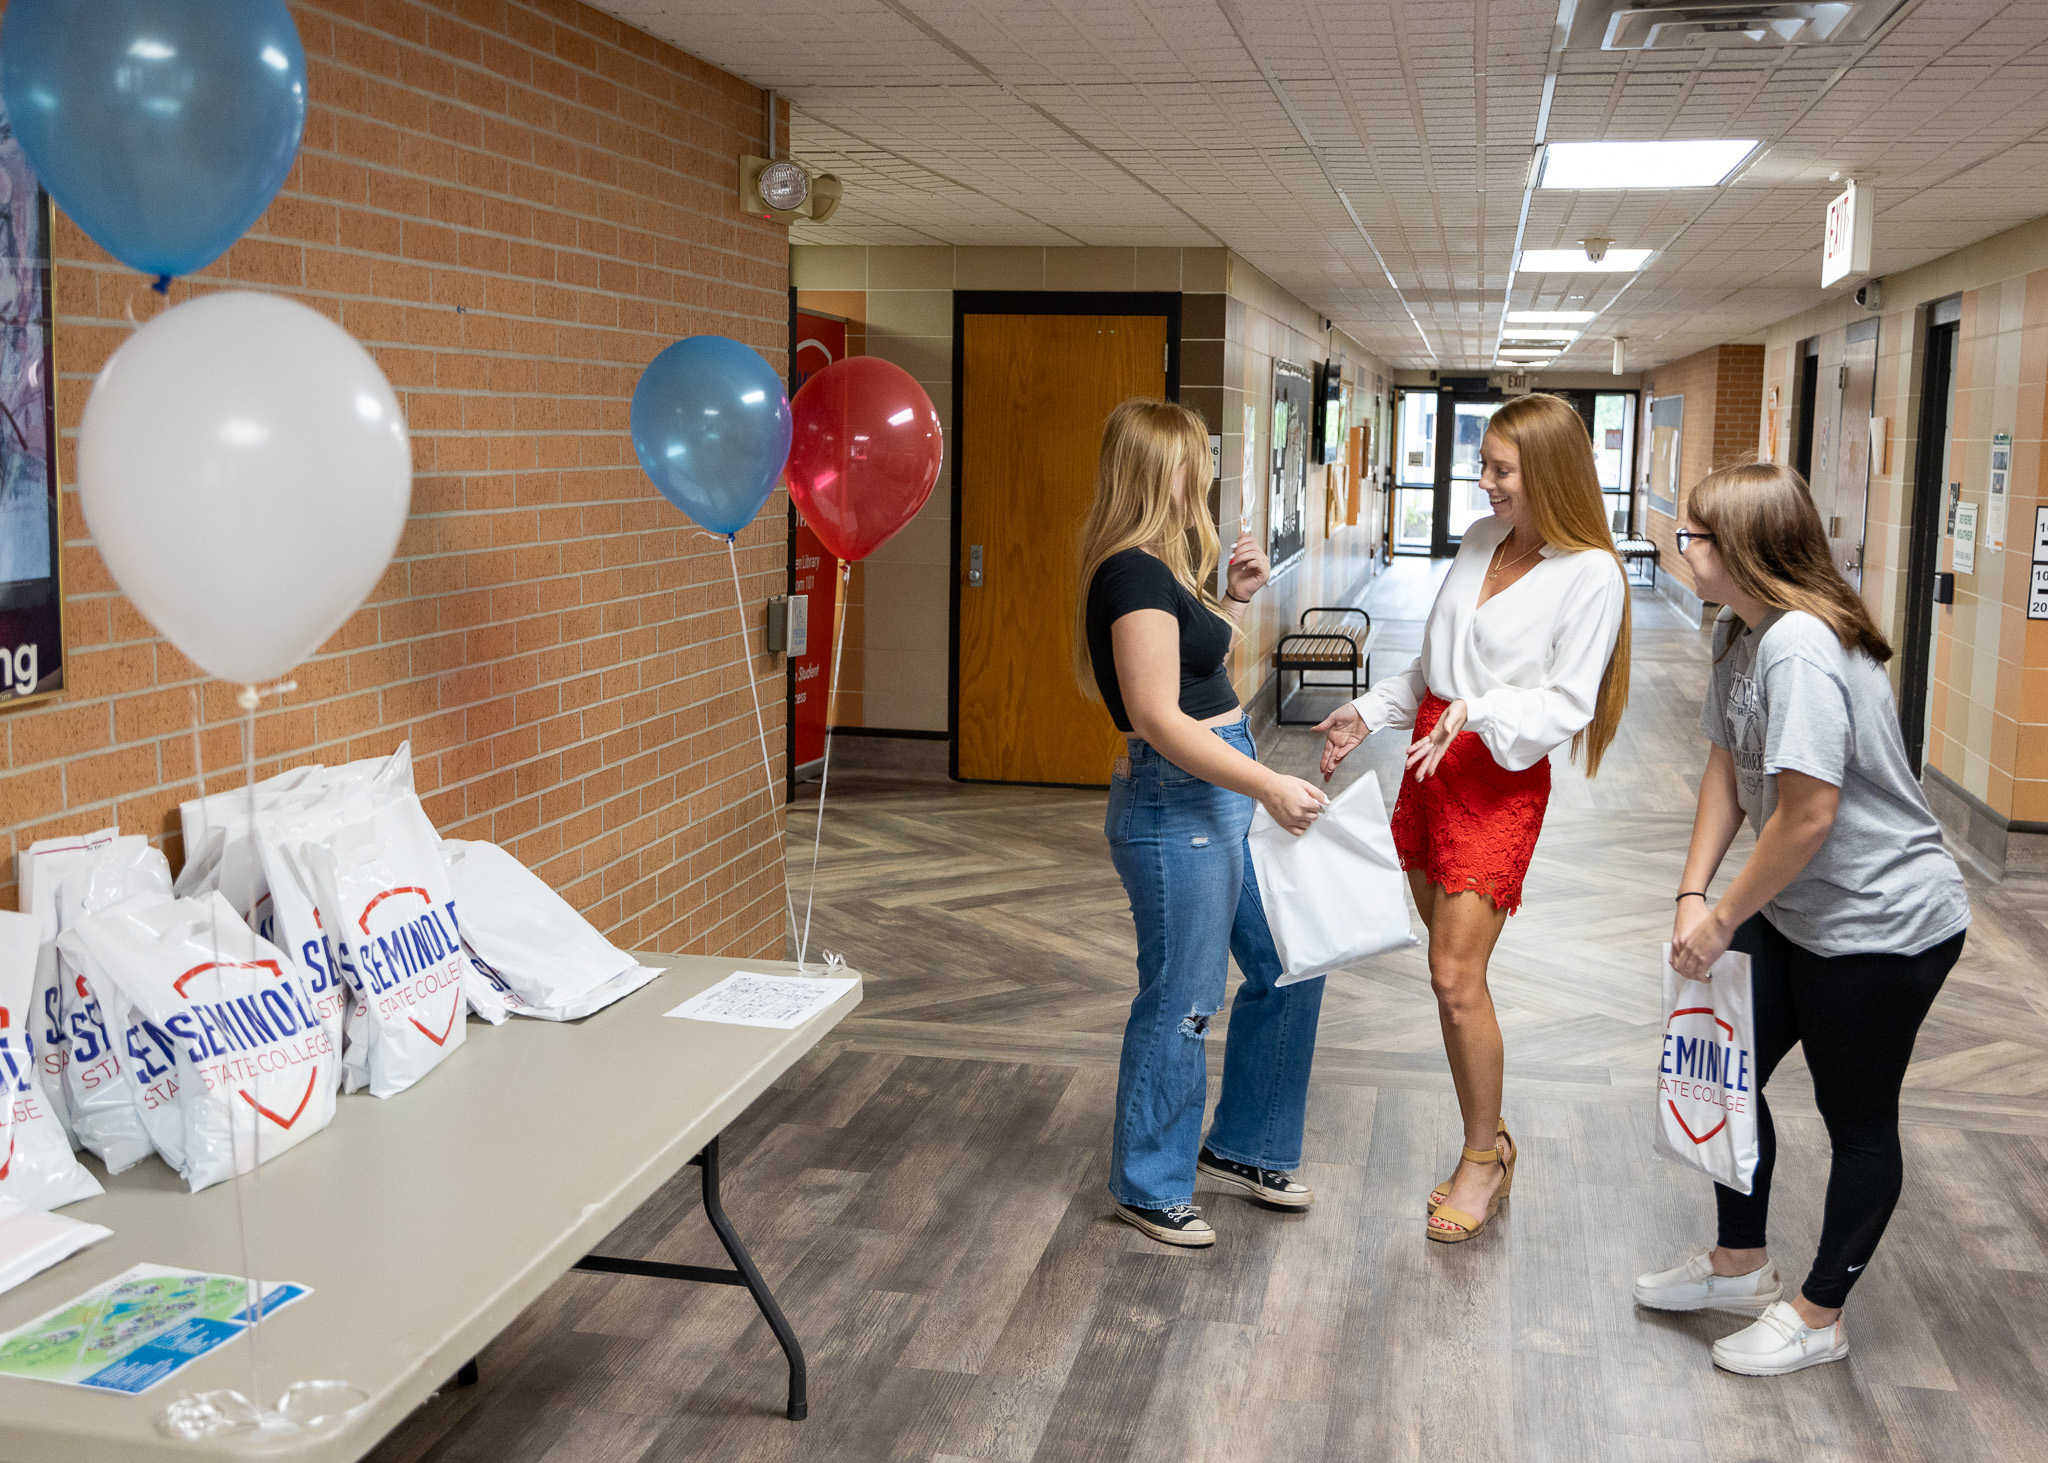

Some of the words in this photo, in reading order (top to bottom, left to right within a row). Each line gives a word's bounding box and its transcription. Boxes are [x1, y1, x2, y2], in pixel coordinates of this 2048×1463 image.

[1828, 197, 1849, 259] EXIT
[1508, 374, 1527, 388] EXIT
[802, 554, 820, 571] Library
[806, 575, 815, 590] 101
[2035, 570, 2048, 582] 10
[2032, 602, 2048, 613] 20
[0, 644, 38, 695] ng
[798, 662, 820, 682] Student
[379, 988, 416, 1020] STATE
[415, 957, 464, 999] COLLE
[316, 993, 345, 1019] STA
[200, 1057, 260, 1091] STATE
[257, 1033, 333, 1073] COLLEGE
[1660, 1033, 1749, 1093] EMINLE
[144, 1074, 180, 1110] STA
